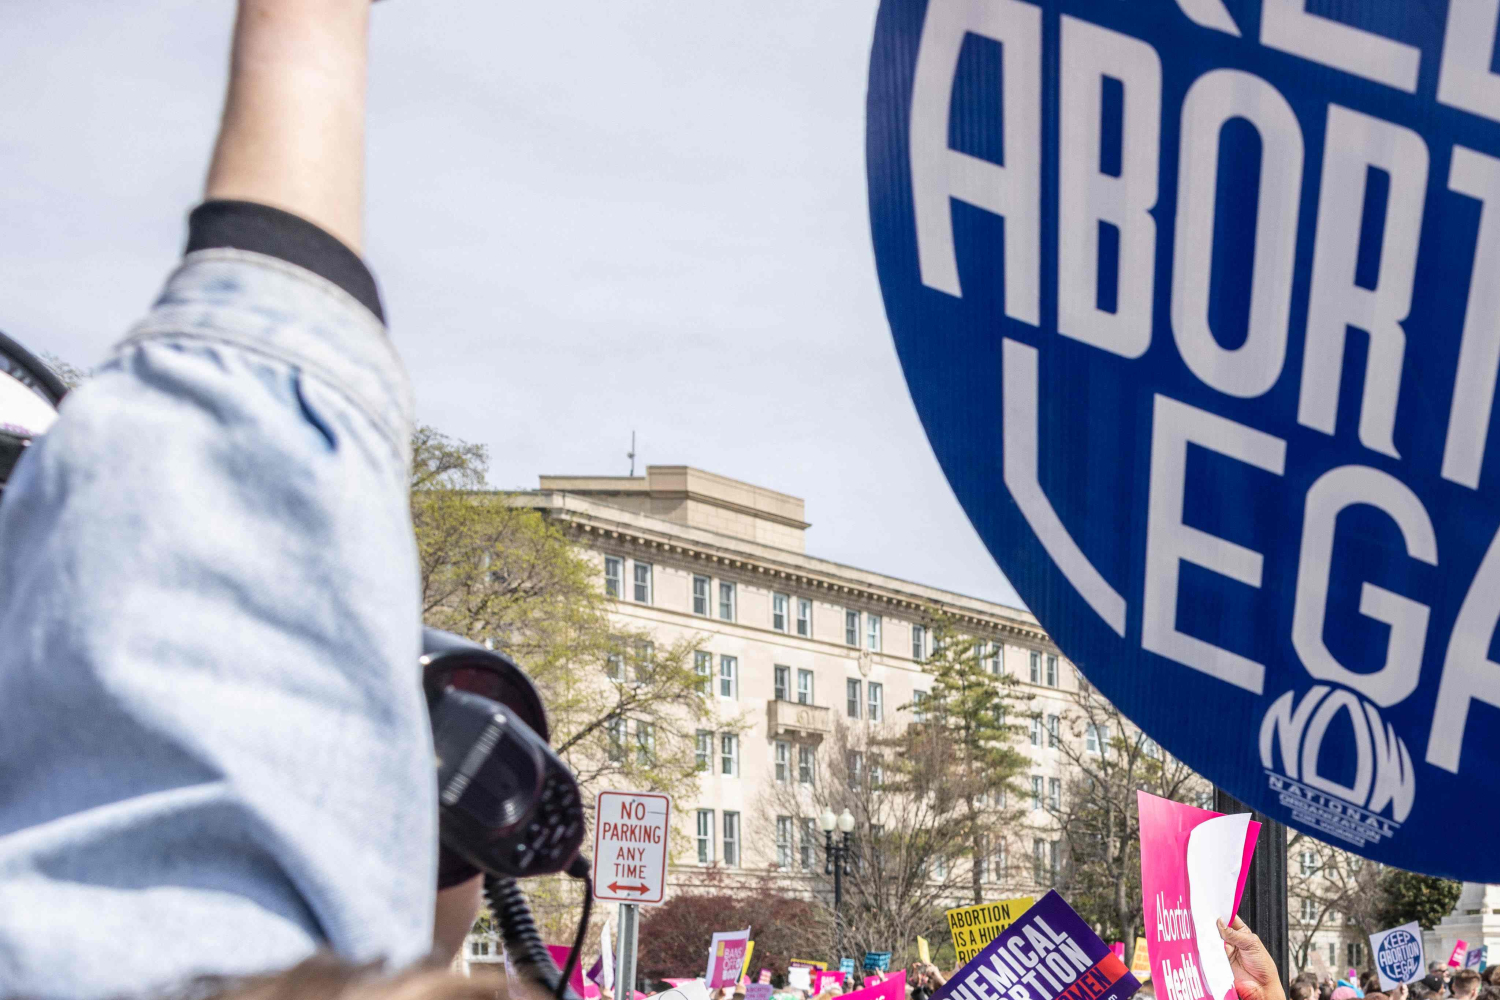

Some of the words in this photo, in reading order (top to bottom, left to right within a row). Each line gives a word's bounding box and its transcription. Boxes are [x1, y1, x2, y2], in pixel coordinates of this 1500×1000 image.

[1259, 685, 1416, 823] NOW
[621, 801, 646, 821] NO
[1269, 776, 1394, 833] NATIONAL
[602, 822, 661, 844] PARKING
[617, 847, 645, 862] ANY
[614, 863, 647, 880] TIME
[950, 904, 1011, 929] ABORTION
[954, 931, 967, 948] IS
[969, 930, 977, 945] A
[979, 923, 1011, 944] HUM
[1383, 931, 1411, 949] KEEP
[1379, 941, 1419, 967] ABORTION
[1386, 959, 1418, 979] LEGAL
